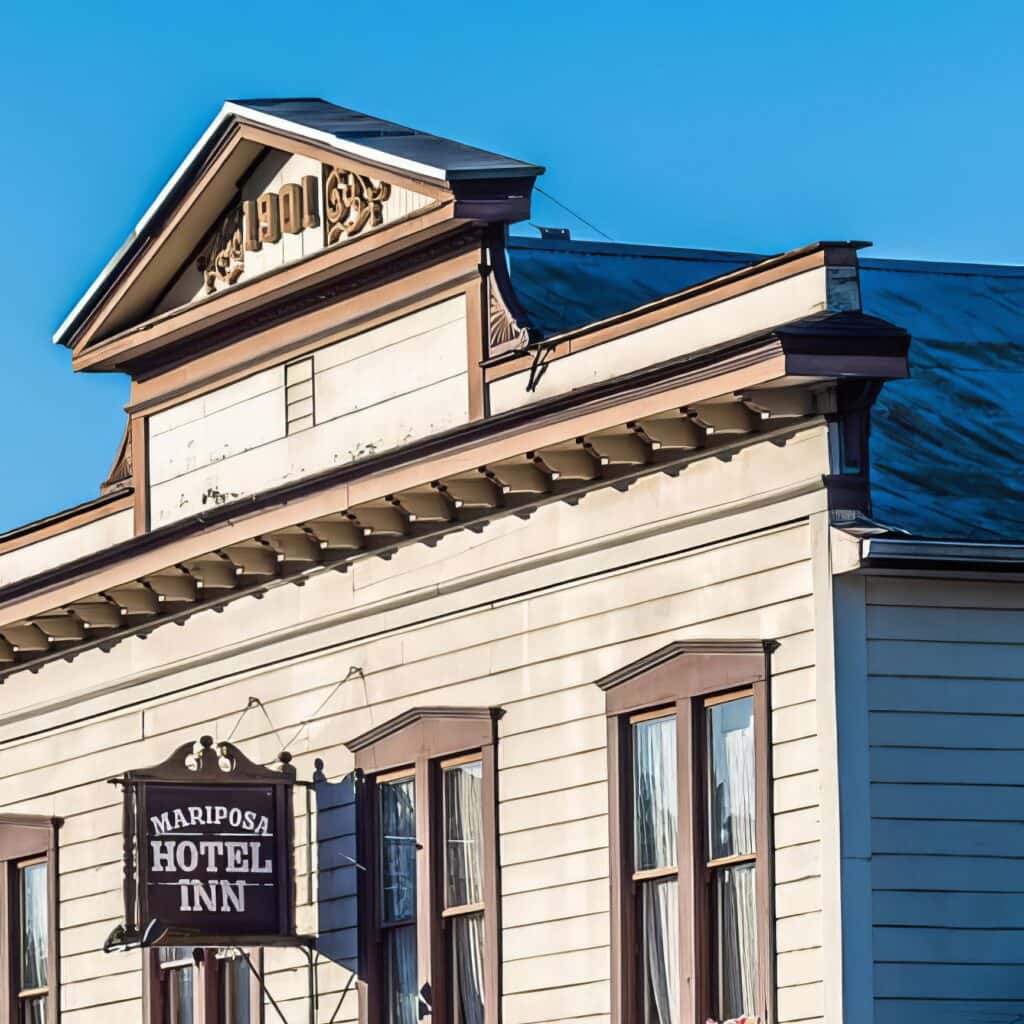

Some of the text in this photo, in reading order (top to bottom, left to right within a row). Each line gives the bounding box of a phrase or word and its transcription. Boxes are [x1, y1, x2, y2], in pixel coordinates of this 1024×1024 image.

[242, 175, 321, 252] 1901
[150, 805, 270, 837] MARIPOSA
[150, 840, 273, 873] HOTEL
[179, 879, 245, 912] INN
